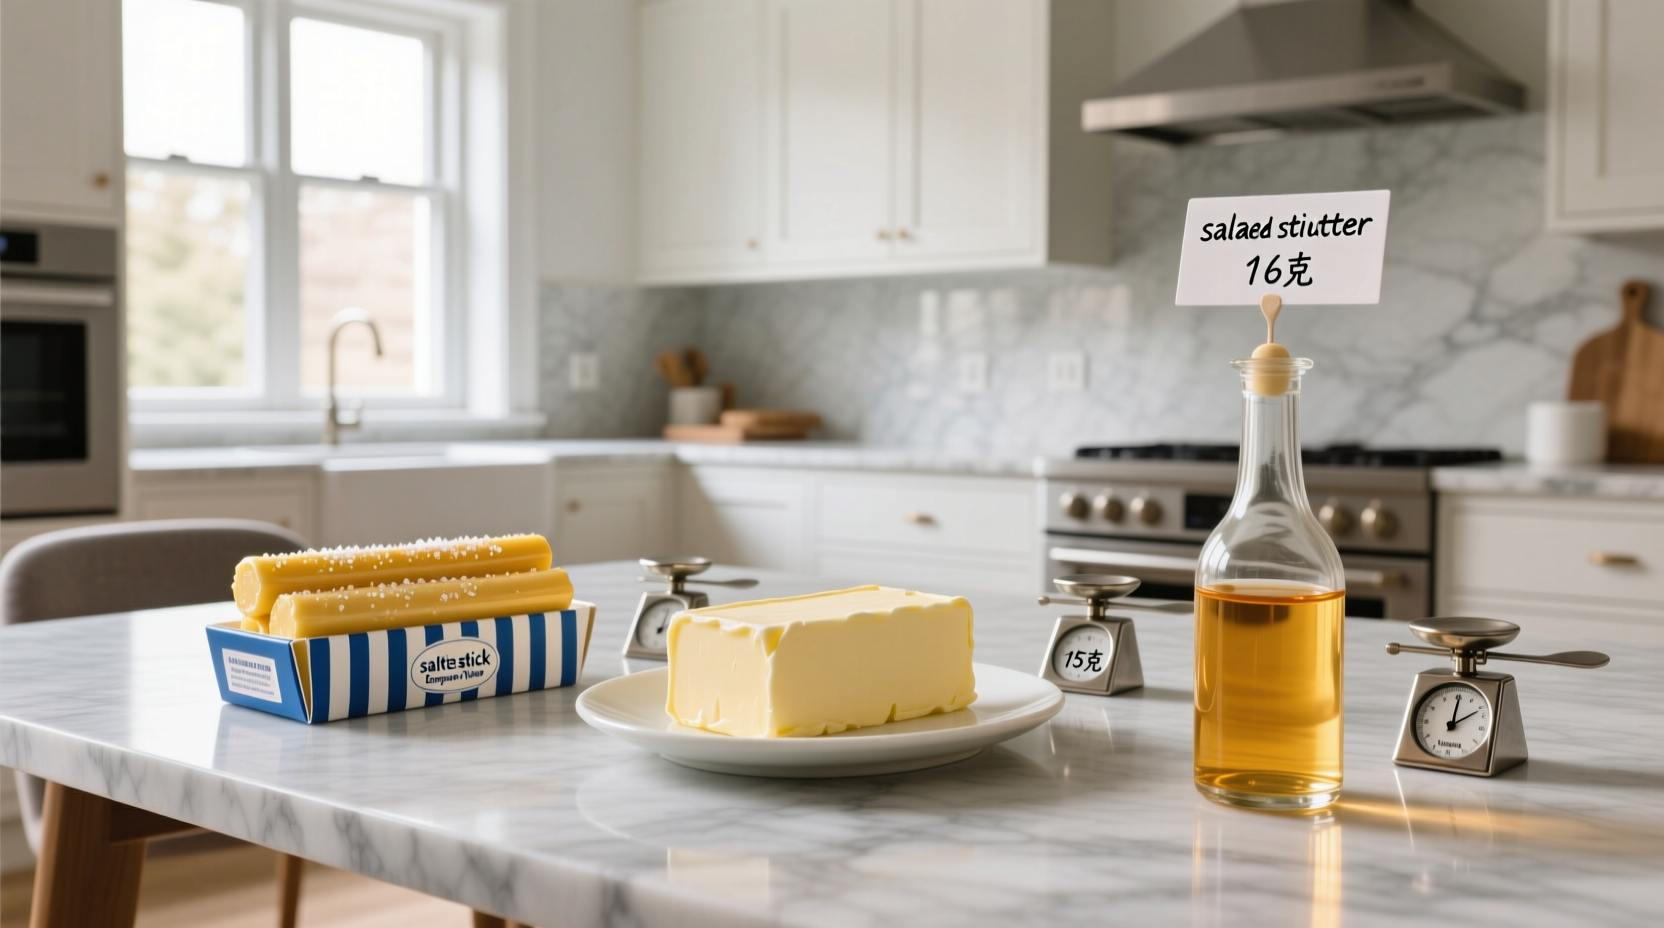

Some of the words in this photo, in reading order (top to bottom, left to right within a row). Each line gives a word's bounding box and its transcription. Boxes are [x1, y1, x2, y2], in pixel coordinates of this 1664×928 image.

[1199, 212, 1274, 242] salaed
[1277, 212, 1374, 239] stiutter
[1246, 251, 1314, 288] 16克
[1064, 649, 1104, 673] 15克
